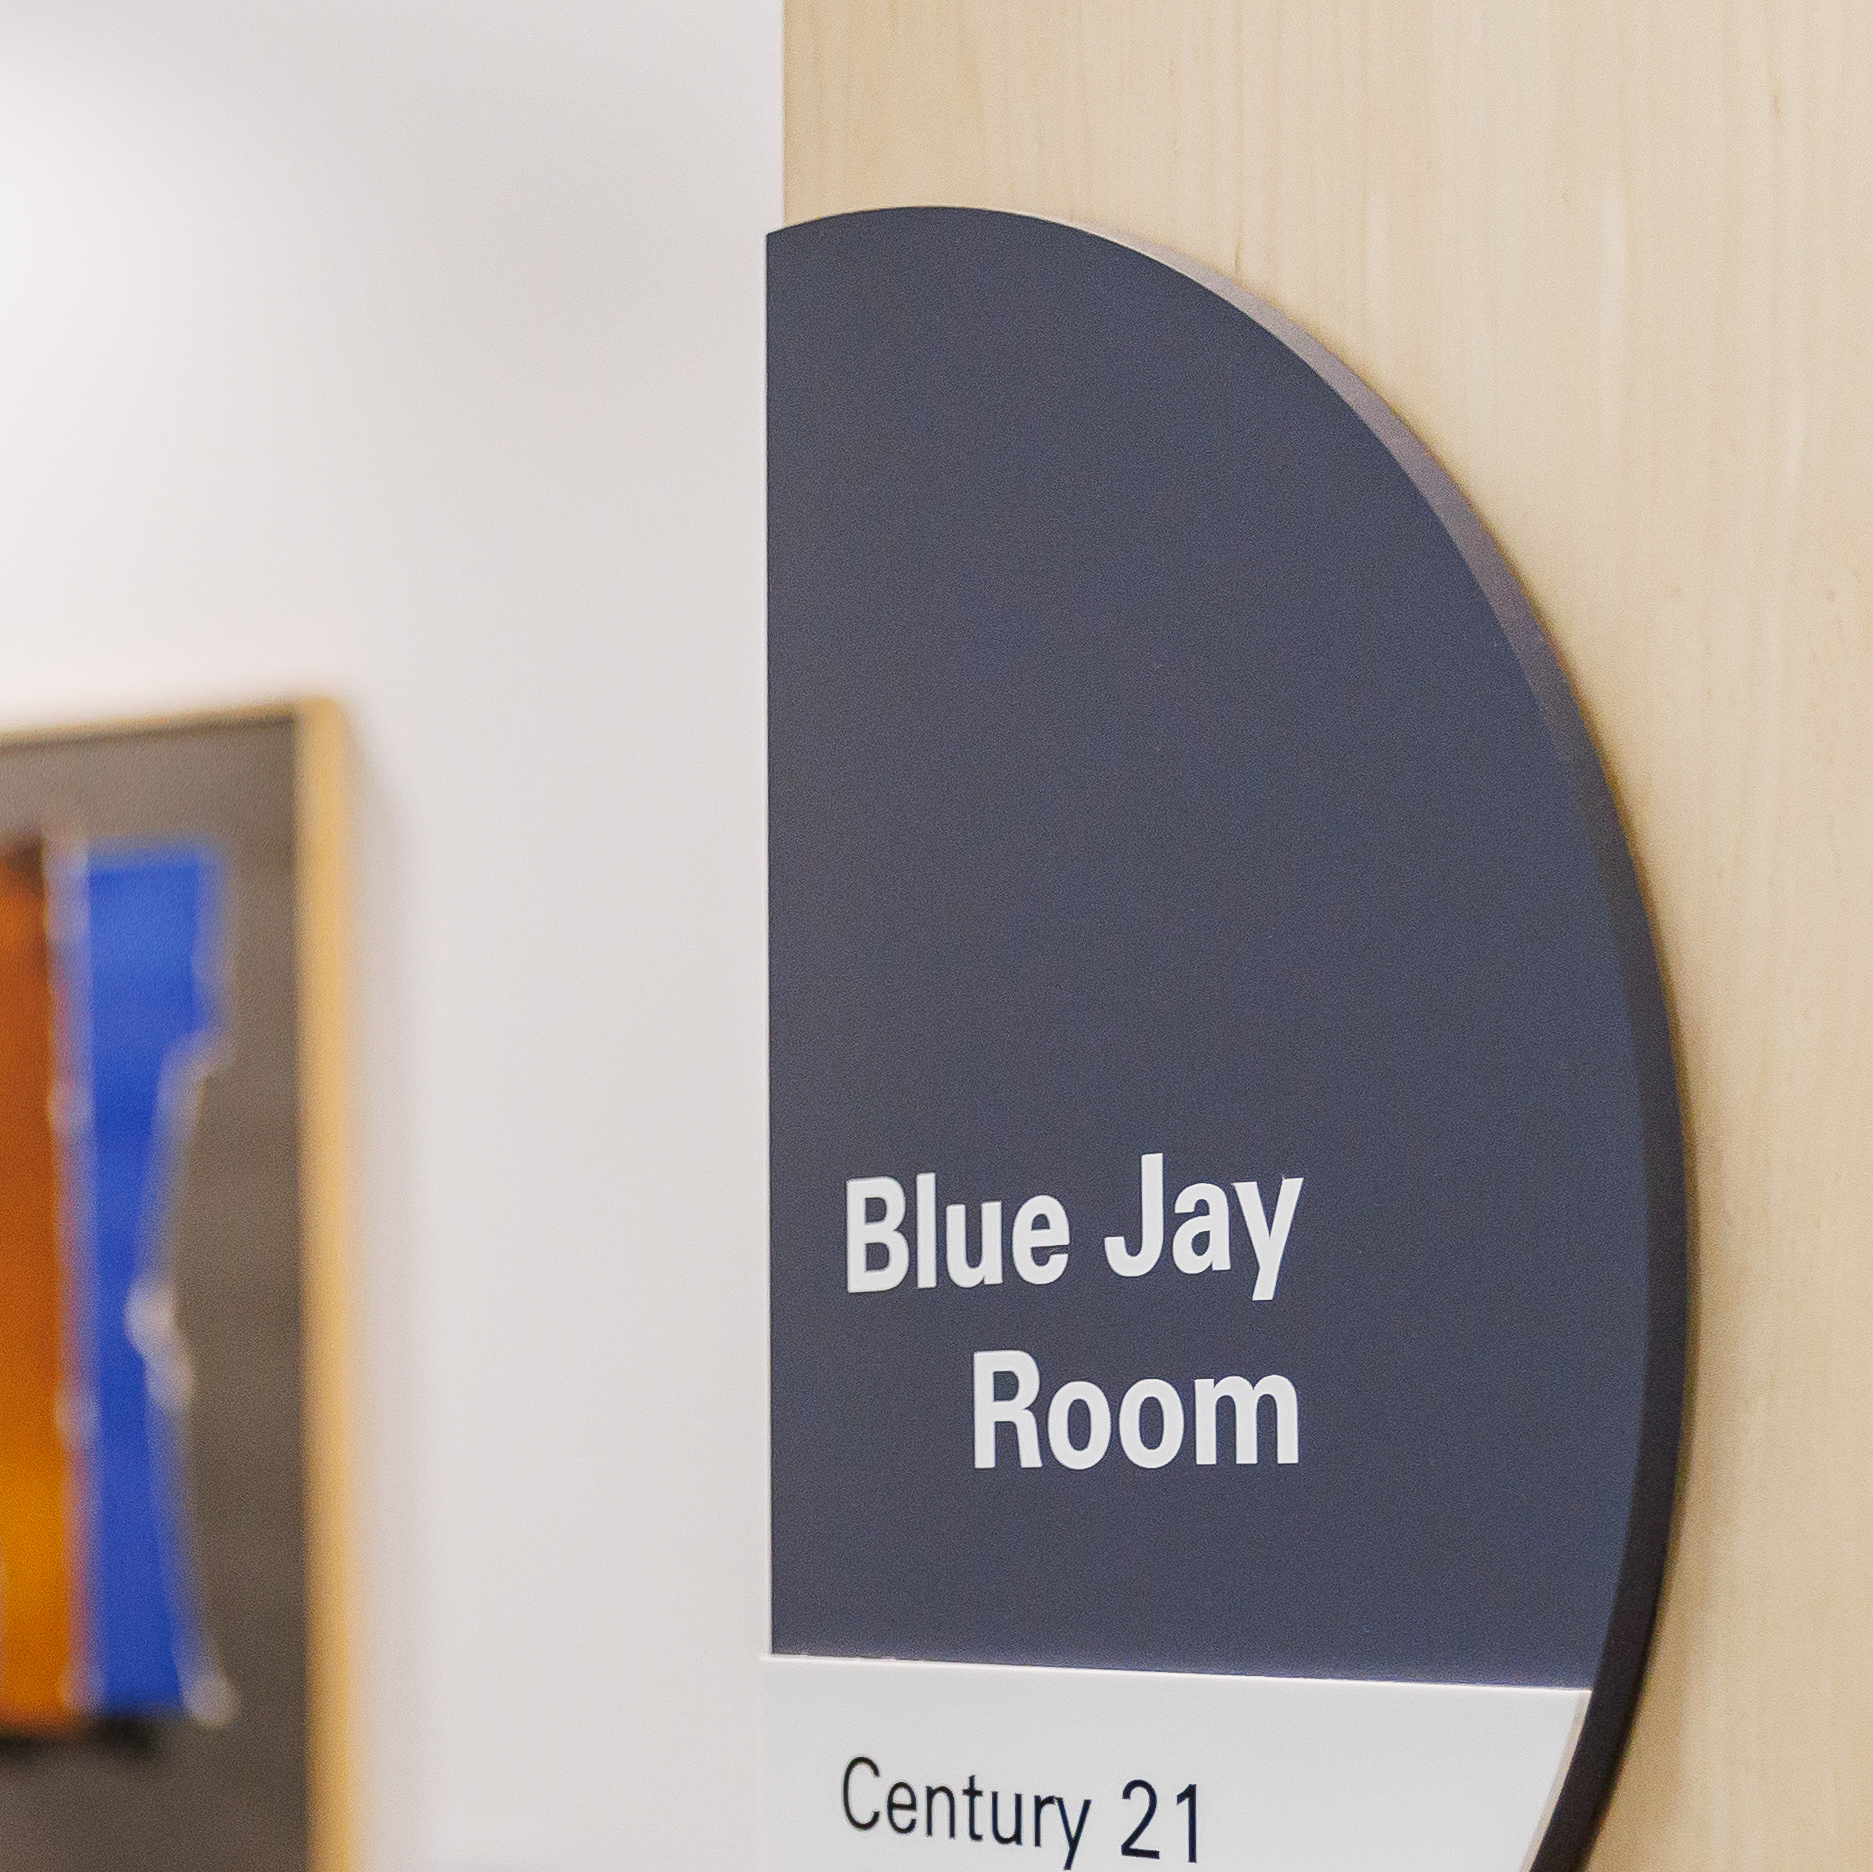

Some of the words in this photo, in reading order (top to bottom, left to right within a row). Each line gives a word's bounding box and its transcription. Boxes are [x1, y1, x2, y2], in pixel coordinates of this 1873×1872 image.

[846, 1172, 1070, 1293] Blue
[1104, 1152, 1304, 1301] Jay
[973, 1349, 1299, 1470] Room
[842, 1756, 1092, 1871] Century
[1120, 1779, 1199, 1864] 21
